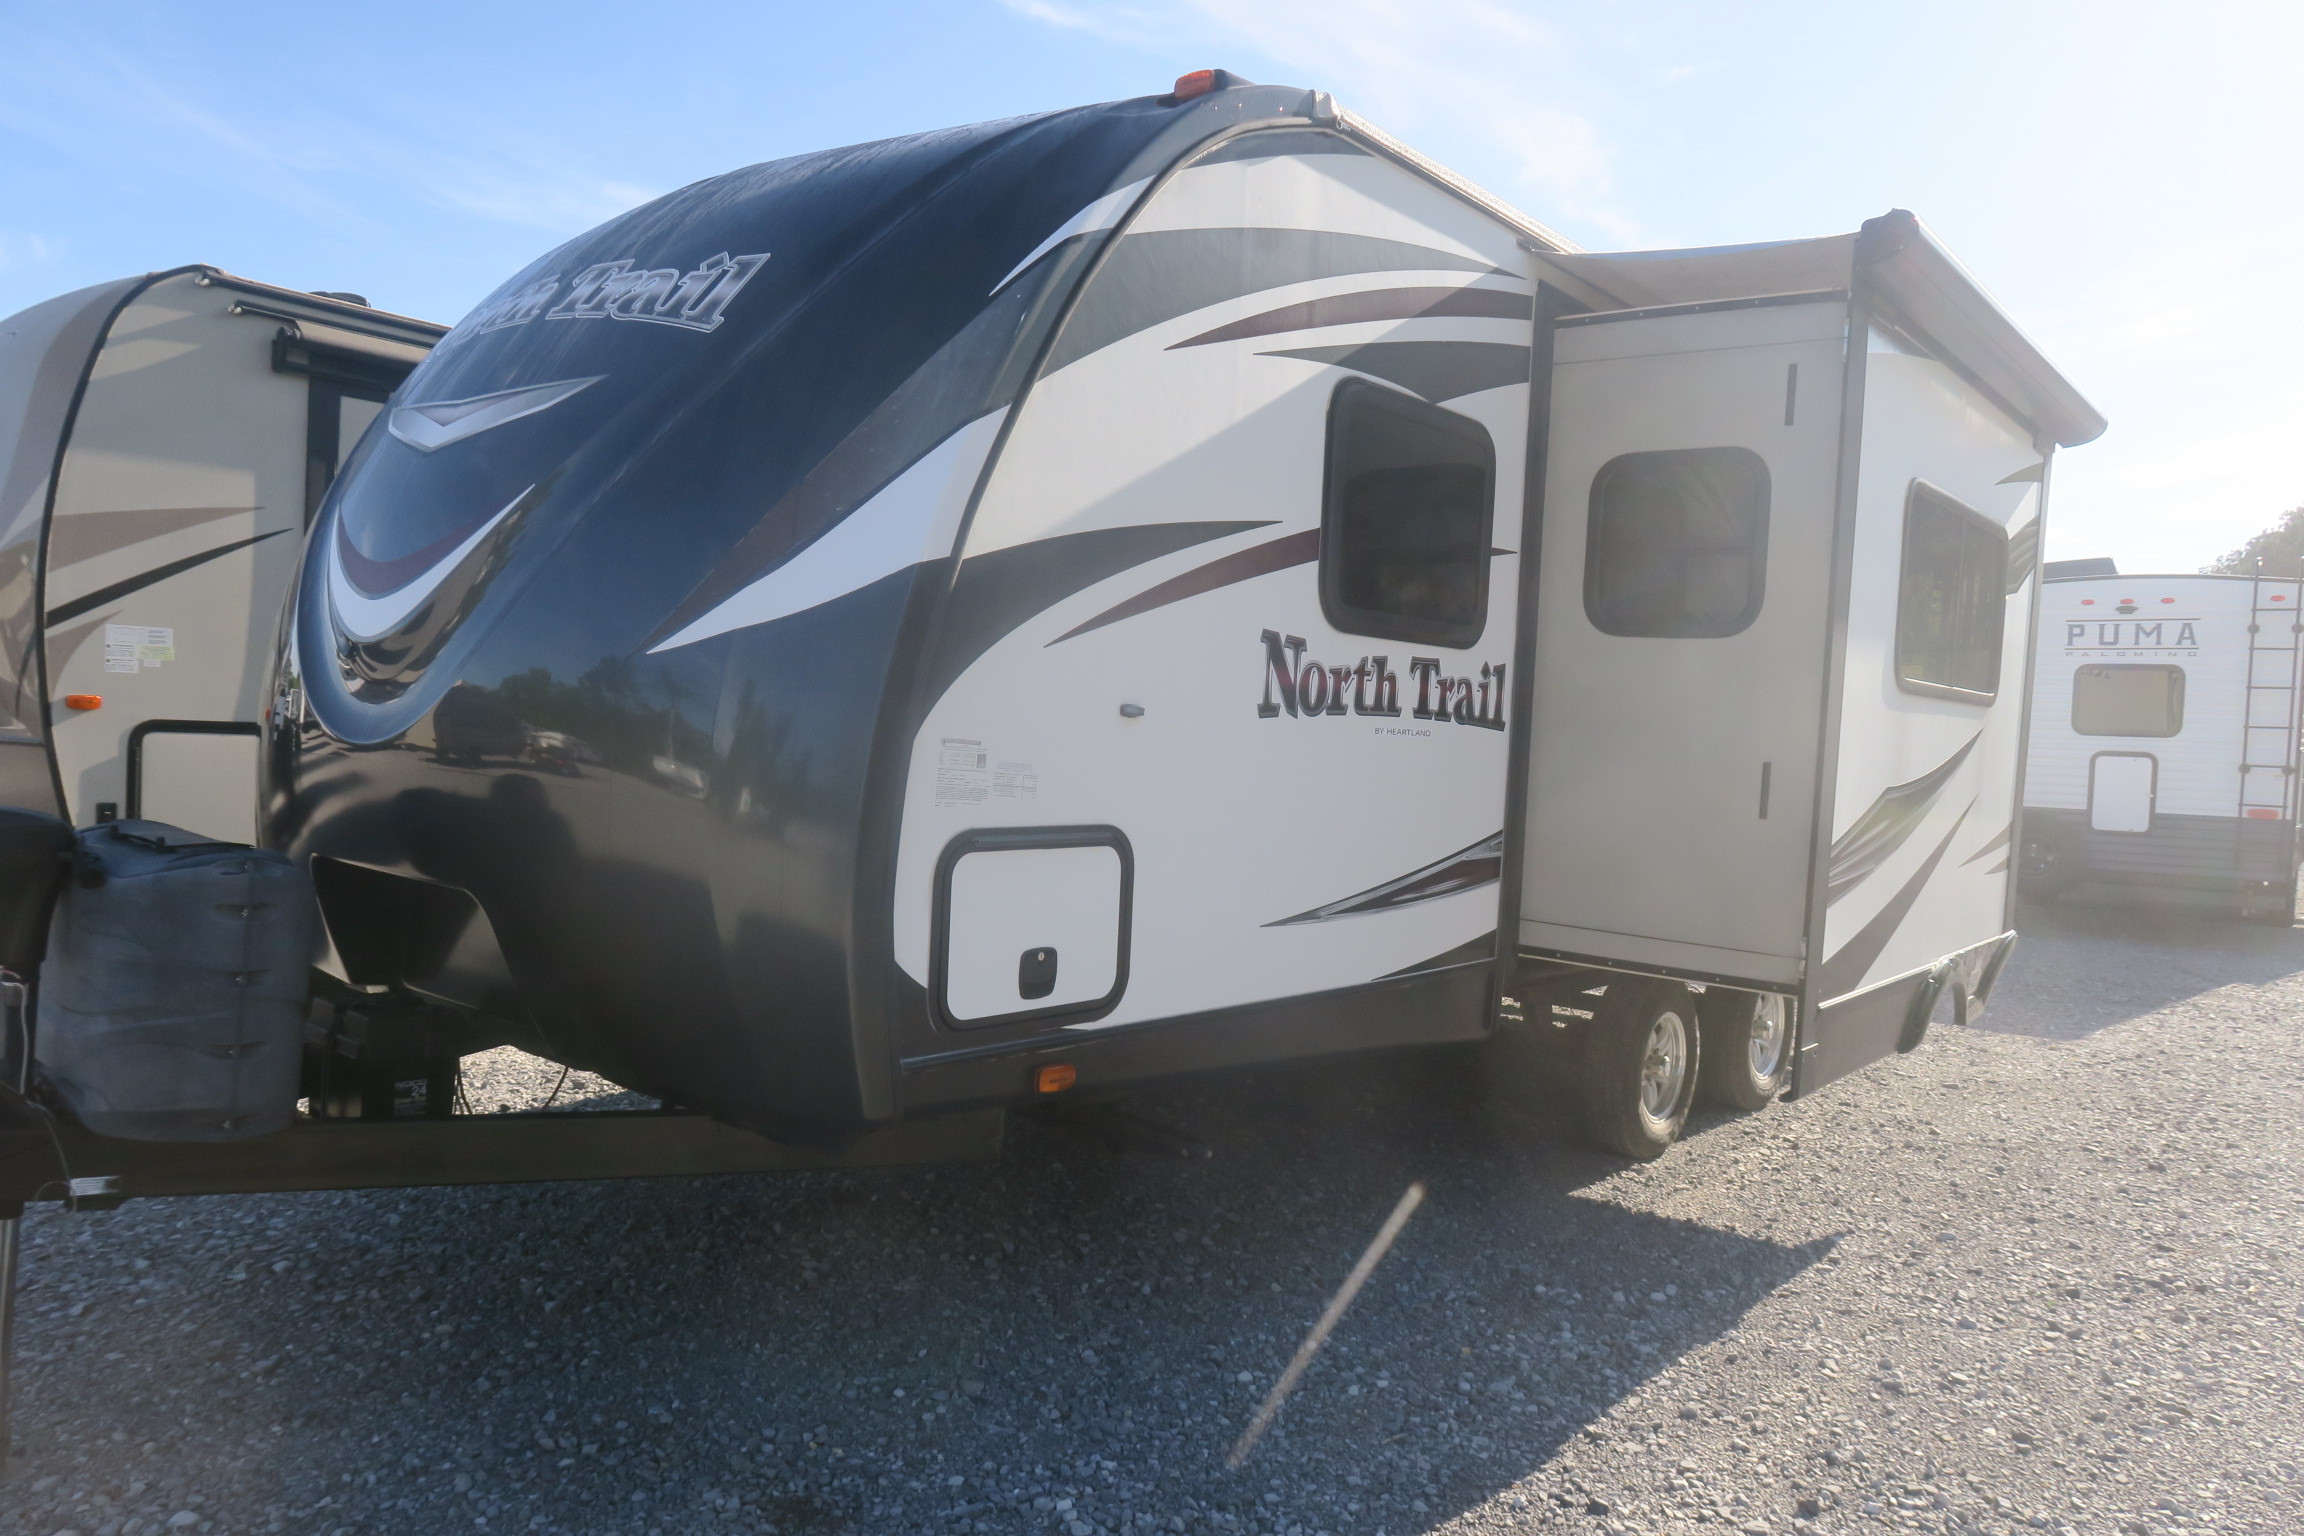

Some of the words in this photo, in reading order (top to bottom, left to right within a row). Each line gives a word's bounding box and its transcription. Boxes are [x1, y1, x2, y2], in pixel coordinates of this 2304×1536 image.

[546, 252, 771, 333] Trail
[2066, 622, 2197, 646] PUMA
[1257, 628, 1401, 719] North
[1409, 655, 1506, 732] Trail
[1374, 727, 1384, 735] BY
[1386, 728, 1431, 737] HEARTLAND
[395, 1079, 427, 1088] NOCO
[411, 1085, 427, 1097] 24
